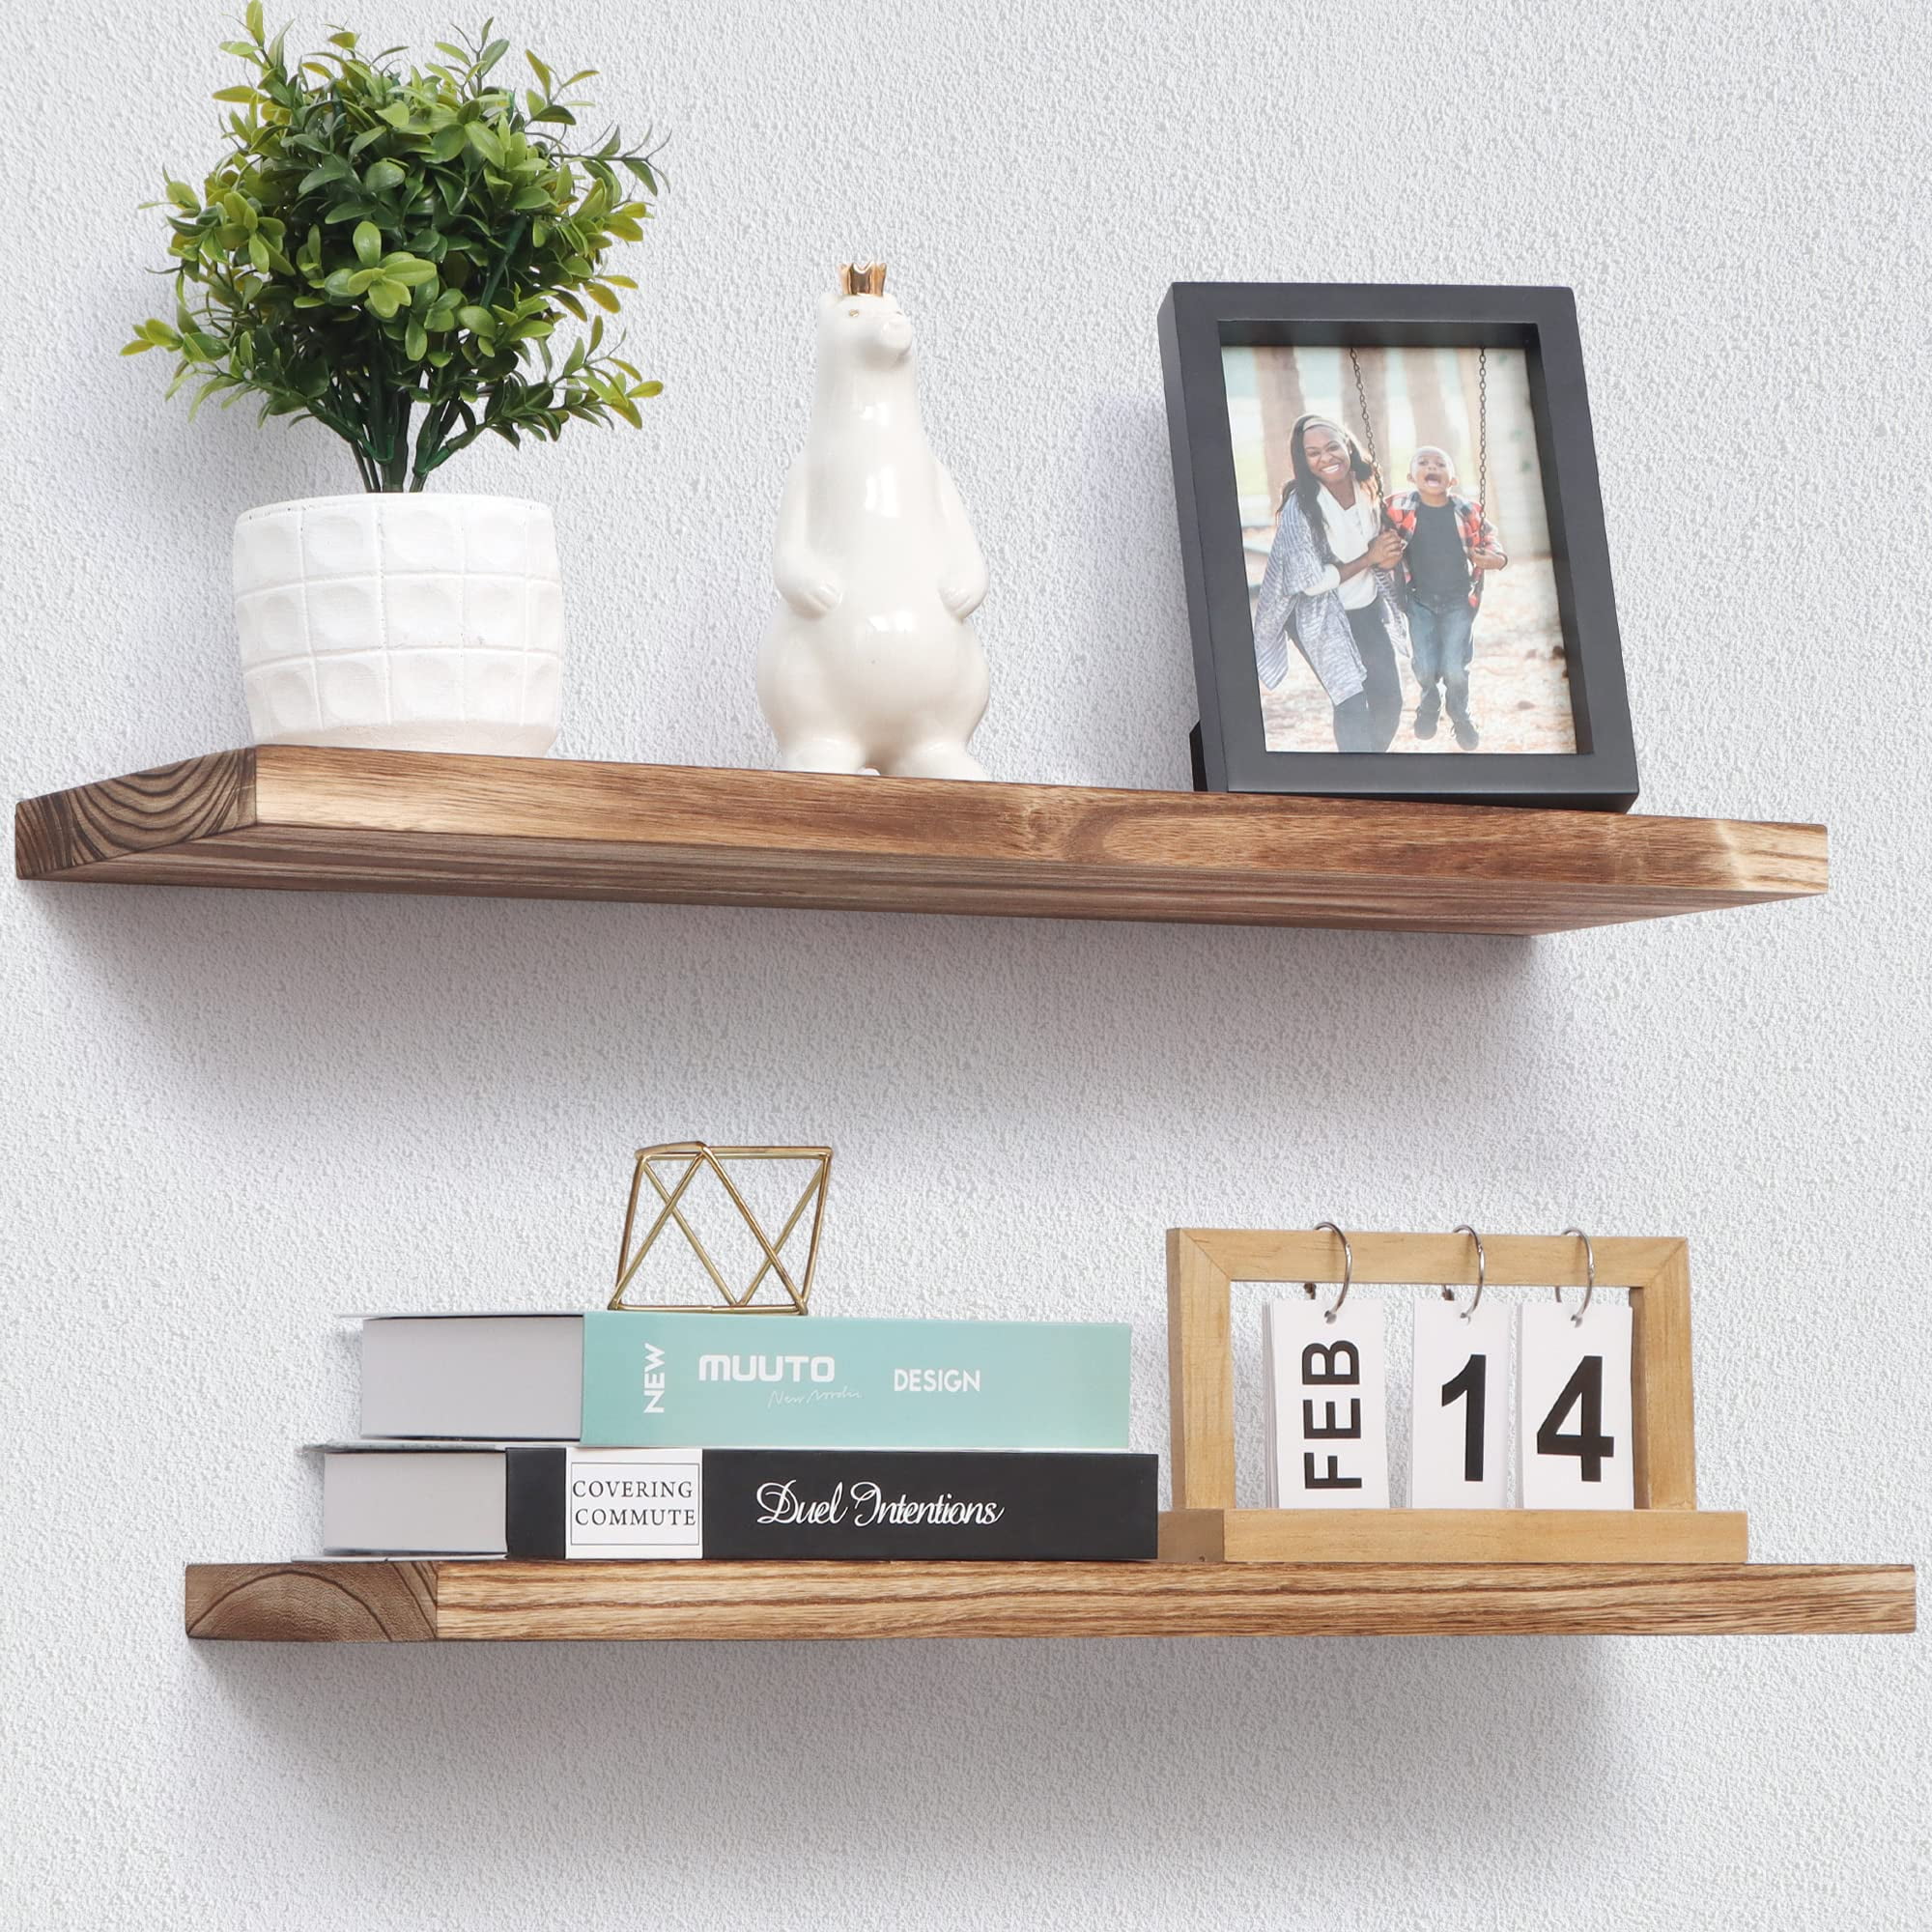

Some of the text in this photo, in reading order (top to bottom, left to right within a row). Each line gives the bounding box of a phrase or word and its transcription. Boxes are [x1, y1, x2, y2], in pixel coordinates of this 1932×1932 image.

[643, 1343, 665, 1413] NEW
[698, 1354, 835, 1382] MUUTO
[894, 1368, 980, 1392] DESIGN
[1301, 1339, 1363, 1490] FEB
[572, 1480, 693, 1498] COVERING
[756, 1479, 1005, 1527] Duel Intentions
[575, 1508, 696, 1526] COMMUTE
